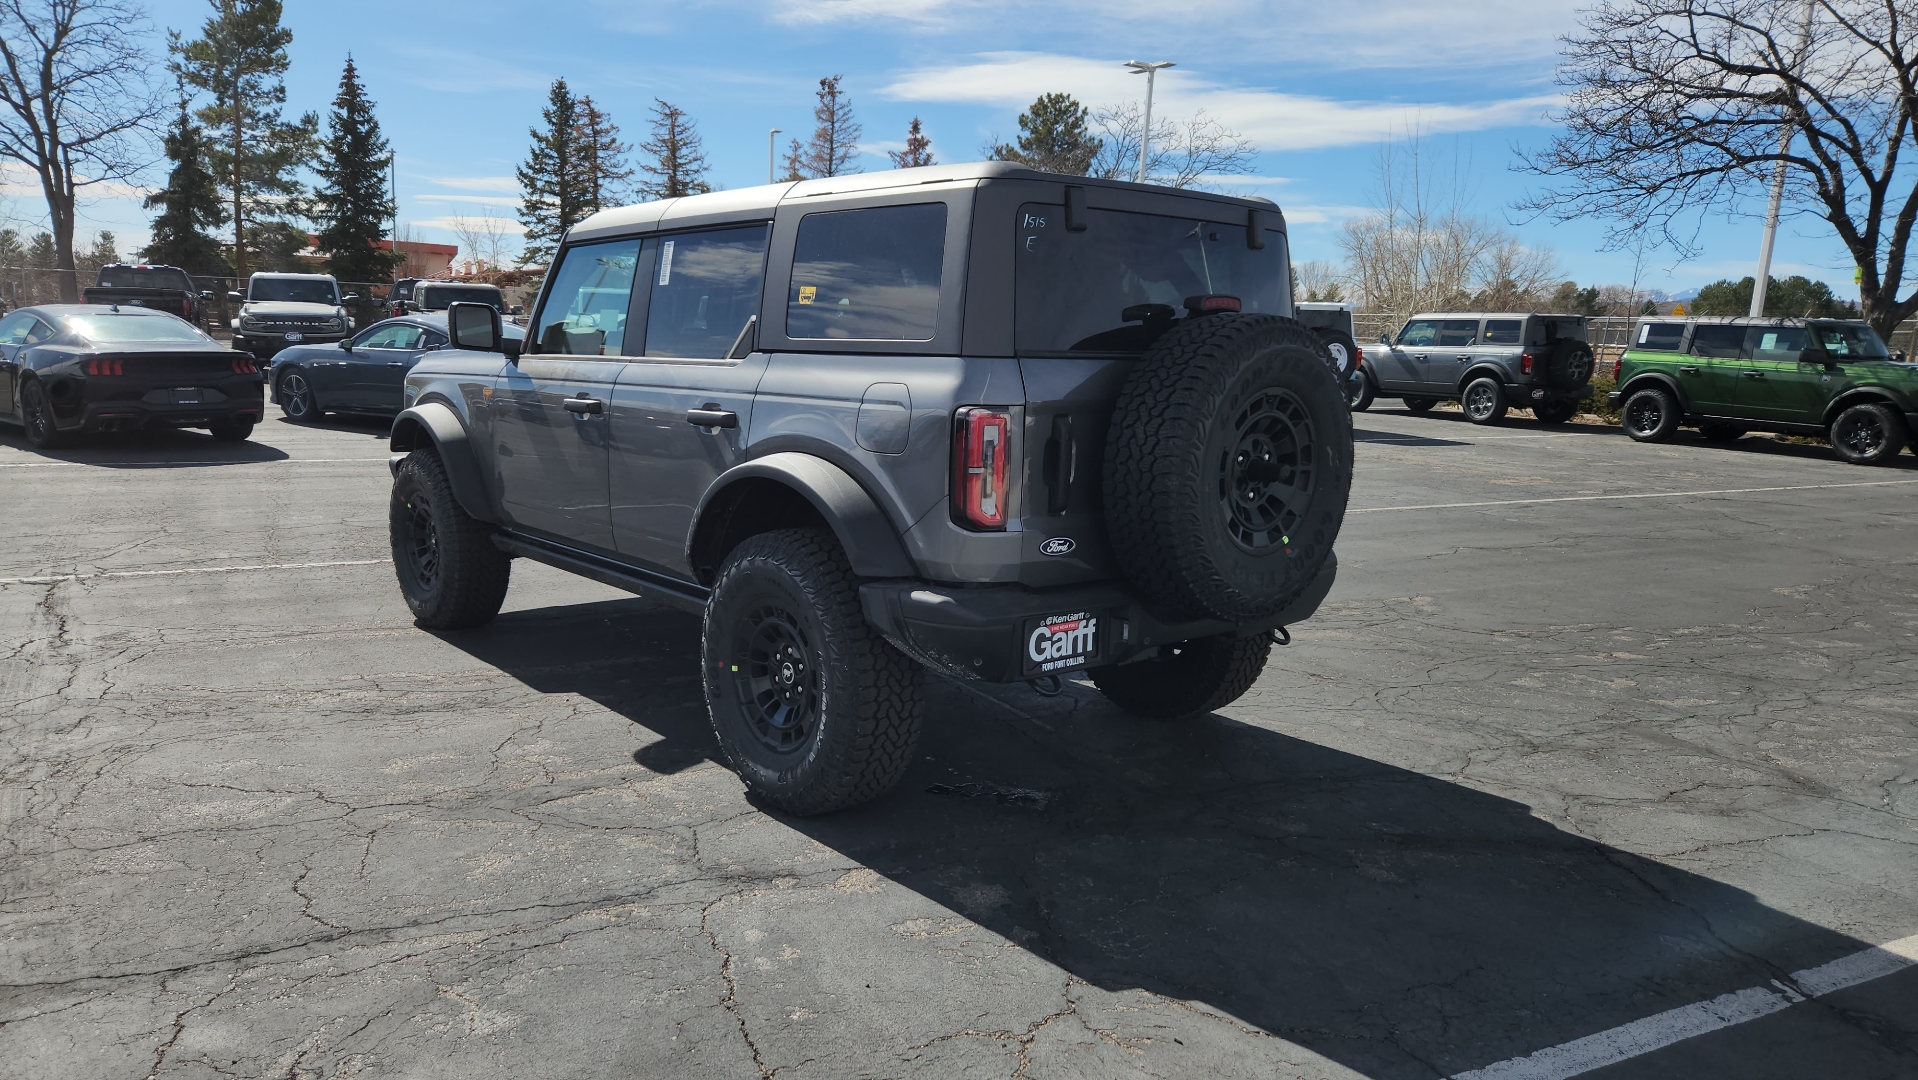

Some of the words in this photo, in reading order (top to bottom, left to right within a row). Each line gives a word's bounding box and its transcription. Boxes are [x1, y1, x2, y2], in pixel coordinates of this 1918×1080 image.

[1023, 213, 1046, 229] 1515
[1046, 539, 1070, 553] Ford
[1052, 615, 1067, 625] Ken
[1067, 612, 1085, 622] Garff
[1028, 618, 1097, 662] Garff
[1041, 661, 1054, 672] FORD
[1054, 659, 1066, 669] FORT
[1066, 655, 1085, 667] COLLINS
